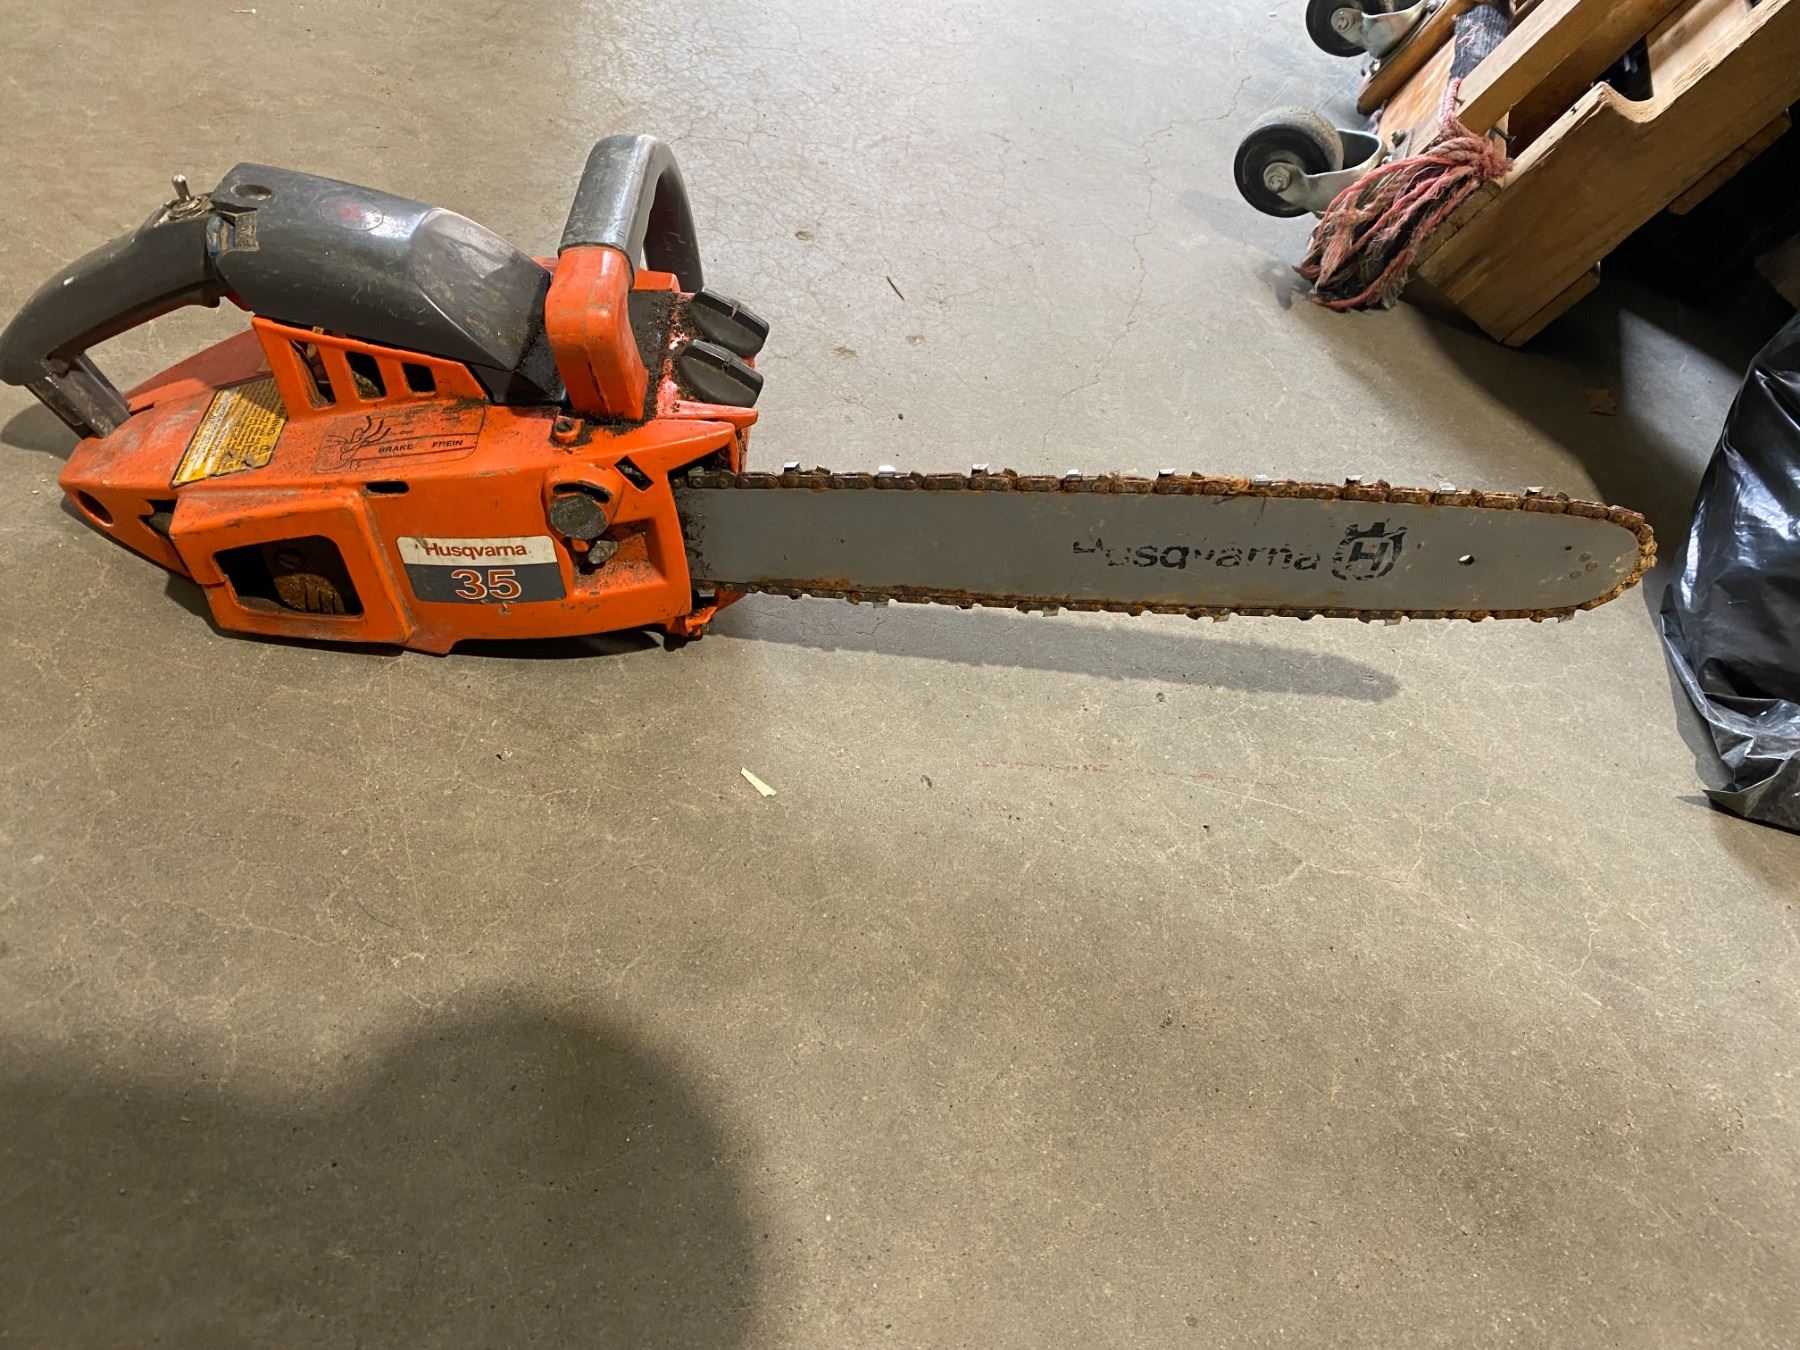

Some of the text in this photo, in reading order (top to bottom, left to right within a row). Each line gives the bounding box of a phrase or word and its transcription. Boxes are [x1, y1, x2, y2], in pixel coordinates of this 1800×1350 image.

[378, 440, 463, 453] BRAKE FREIN
[426, 543, 527, 560] Husqvarna
[451, 569, 522, 600] 35
